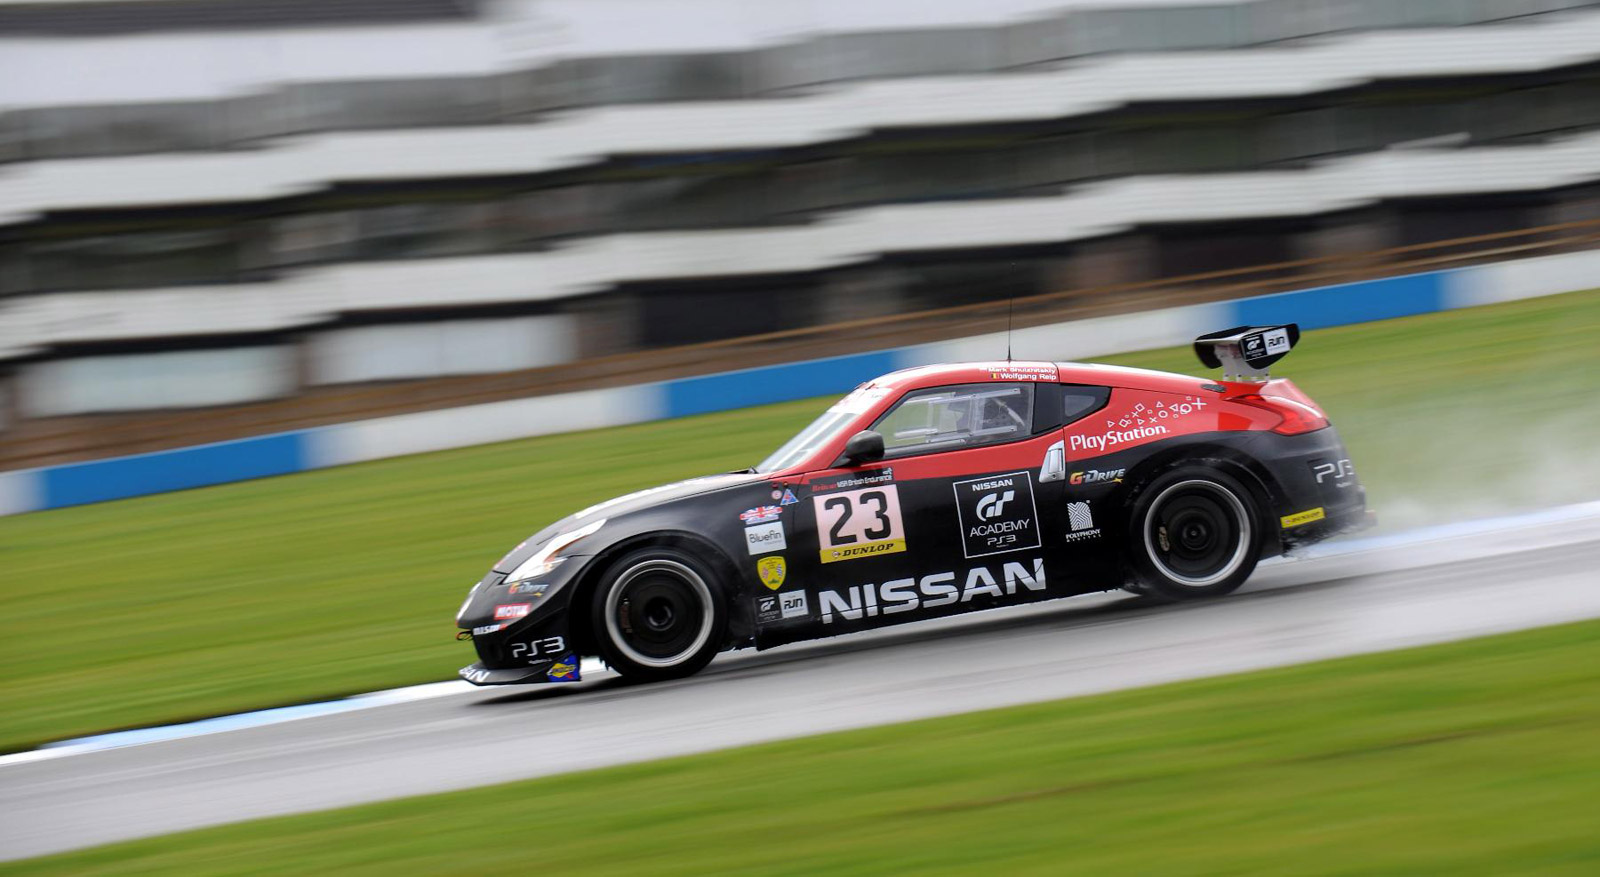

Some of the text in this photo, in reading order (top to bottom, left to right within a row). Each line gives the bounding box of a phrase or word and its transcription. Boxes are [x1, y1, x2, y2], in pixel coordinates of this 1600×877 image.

[1000, 373, 1037, 381] Wolfgang
[1070, 425, 1166, 451] PlayStation
[864, 474, 893, 484] Endurance
[972, 478, 1013, 491] NISSAN
[824, 491, 892, 546] 23
[969, 519, 1030, 538] ACADEMY
[749, 530, 782, 544] Bluefin
[987, 534, 1017, 546] PS3
[842, 543, 894, 557] DUNLOP
[818, 558, 1047, 625] NISSAN
[511, 636, 565, 658] PS3
